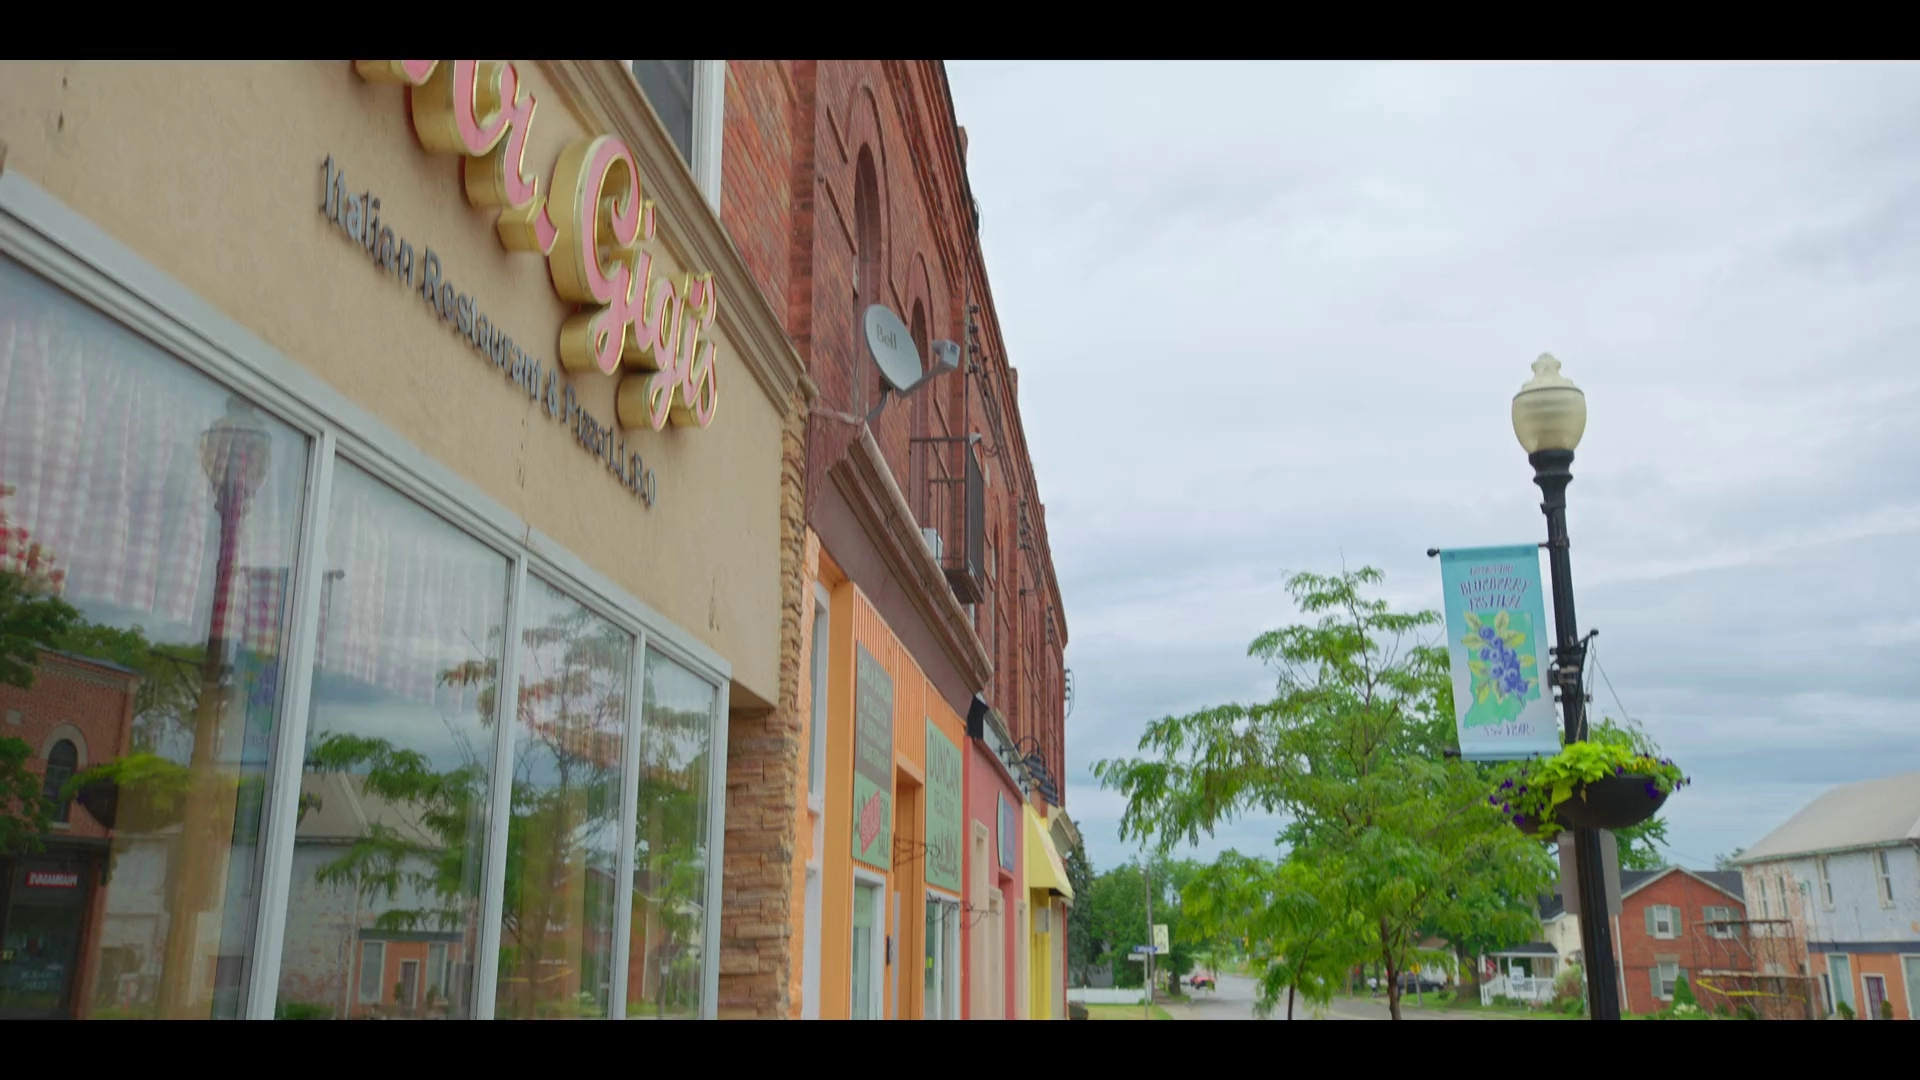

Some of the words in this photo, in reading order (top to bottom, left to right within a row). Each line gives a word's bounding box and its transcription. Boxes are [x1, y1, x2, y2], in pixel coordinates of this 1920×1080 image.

[320, 153, 414, 290] Italian
[420, 245, 543, 402] Restaurant
[546, 367, 559, 420] &
[563, 383, 608, 460] Pizza
[549, 134, 718, 432] Gigi's
[876, 324, 898, 350] Bell
[929, 730, 960, 796] DUNCAN
[861, 793, 880, 850] SOLD
